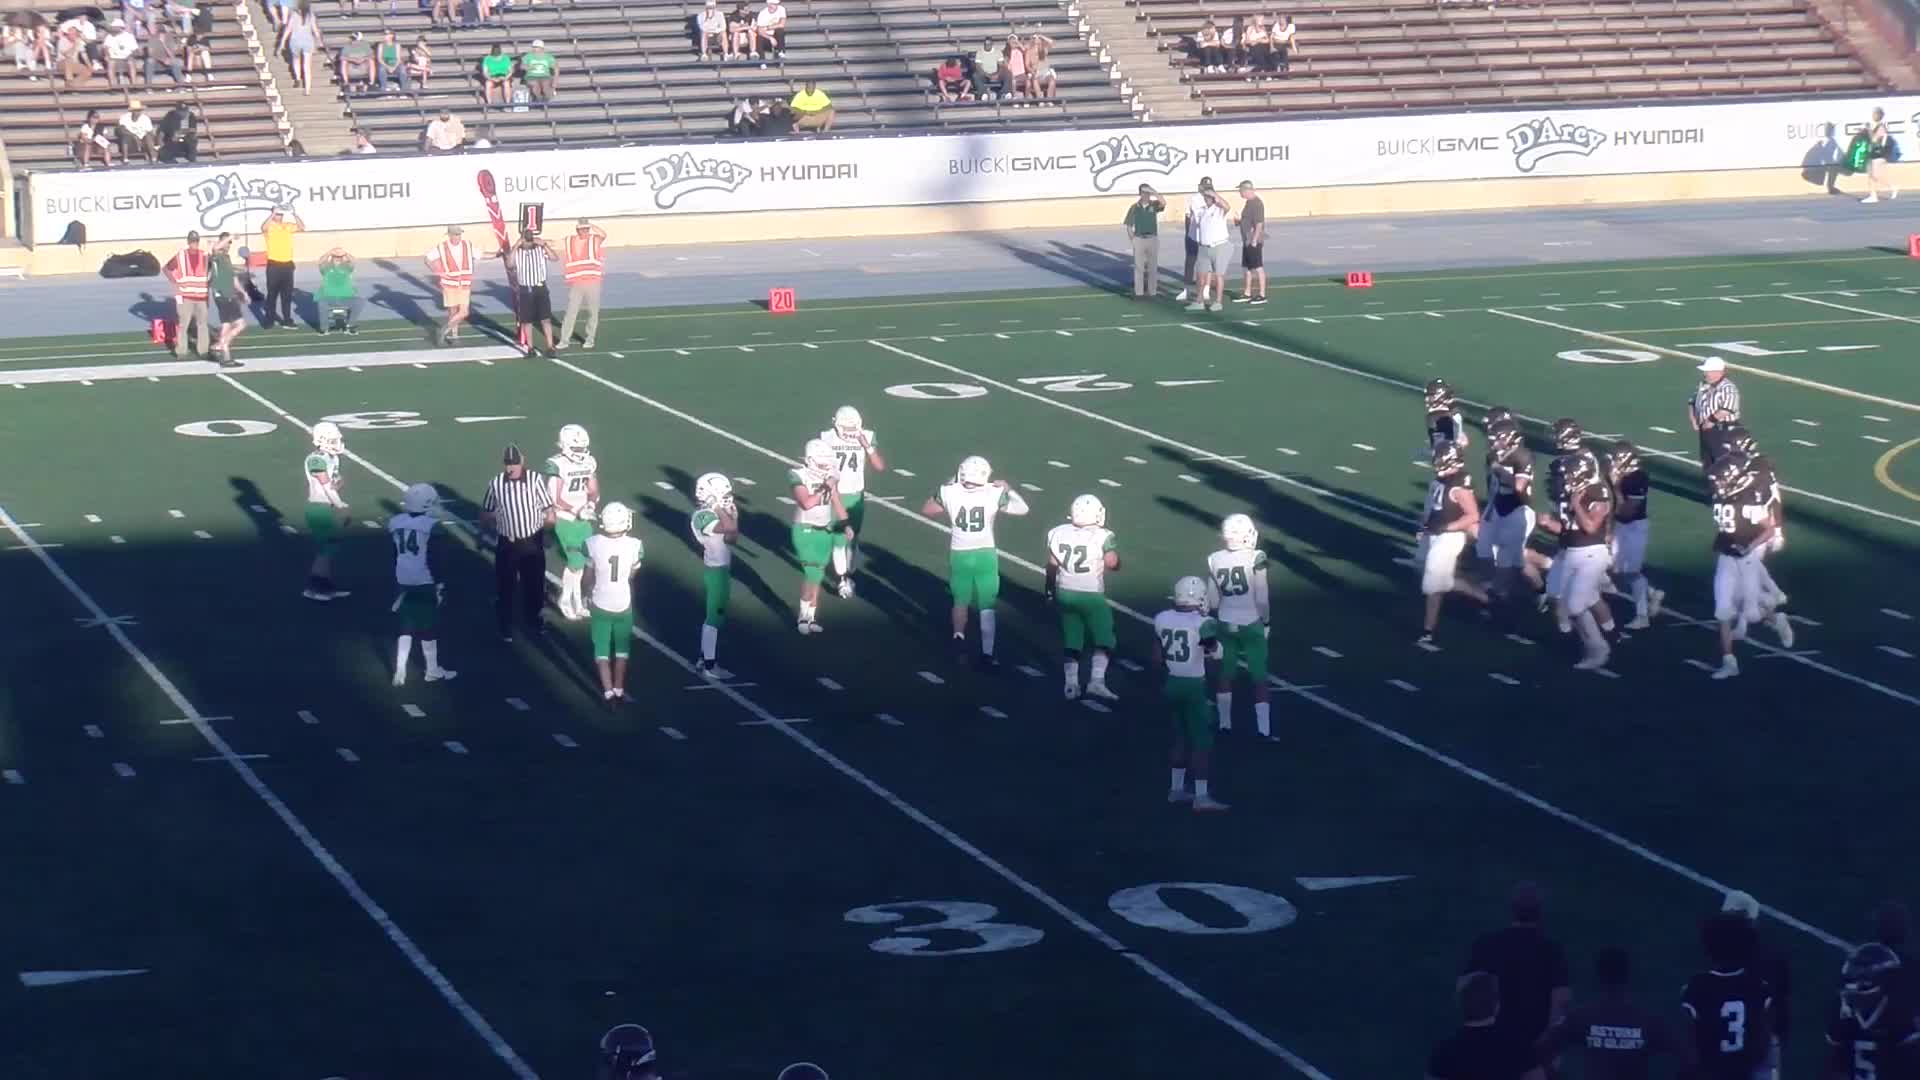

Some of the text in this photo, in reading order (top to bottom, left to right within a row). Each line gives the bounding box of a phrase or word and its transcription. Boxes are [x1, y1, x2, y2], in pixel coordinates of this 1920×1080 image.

[1378, 138, 1431, 156] BUICK
[1437, 136, 1499, 152] GMC
[1614, 128, 1704, 147] HYUNDAI
[949, 156, 1004, 175] BUICK
[1012, 155, 1077, 171] GMC
[1195, 145, 1290, 164] HYUNDAI
[504, 174, 561, 193] BUICK
[569, 171, 636, 188] GMC
[760, 163, 858, 182] HYUNDAI
[46, 195, 105, 214] BUICK
[113, 192, 182, 210] GMC
[309, 182, 410, 201] HYUNDAI
[527, 206, 537, 231] 1
[774, 291, 792, 310] 20
[835, 452, 859, 472] 74
[954, 506, 985, 532] 49
[397, 530, 420, 556] 14
[608, 555, 619, 582] 1
[1058, 544, 1090, 573] 72
[1216, 566, 1249, 596] 29
[1160, 629, 1190, 663] 23
[1719, 1000, 1746, 1052] 3
[1855, 1040, 1877, 1080] 5
